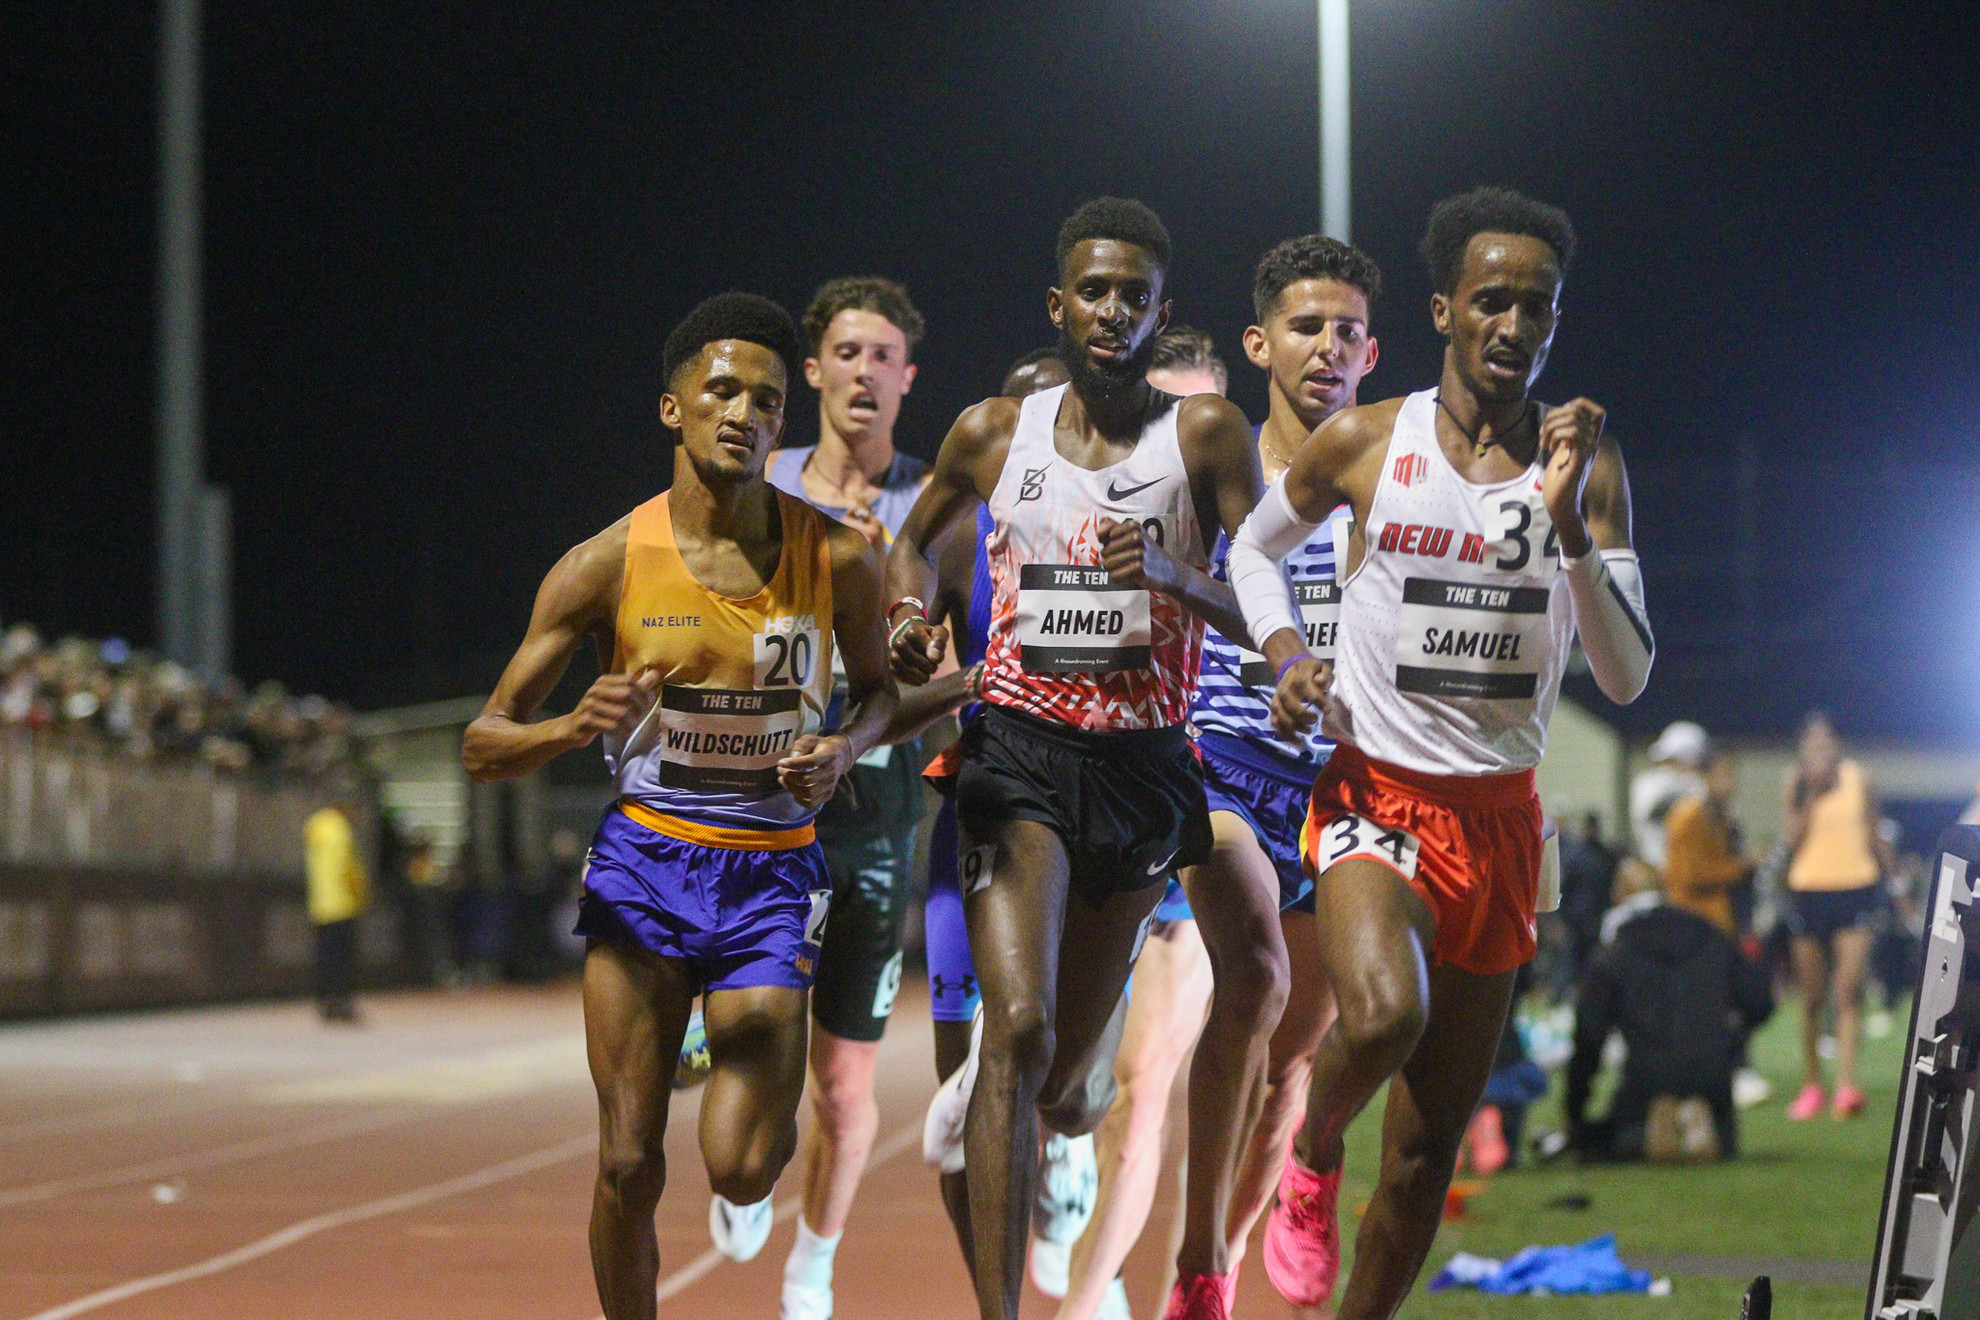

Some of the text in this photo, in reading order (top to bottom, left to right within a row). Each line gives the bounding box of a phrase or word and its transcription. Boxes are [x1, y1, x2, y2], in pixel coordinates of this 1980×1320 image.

[1378, 522, 1454, 558] NEW
[1054, 570, 1109, 585] THE TEN
[1304, 585, 1331, 600] TEN
[1445, 586, 1510, 608] THE TEN
[642, 616, 701, 628] NAZ ELITE
[764, 614, 816, 633] HOKA
[1040, 609, 1124, 635] AHMED
[1422, 627, 1521, 661] SAMUEL
[764, 632, 812, 686] 20
[701, 694, 763, 710] THE TEN
[667, 728, 793, 756] WILDSCHUTT
[1330, 814, 1407, 865] 34
